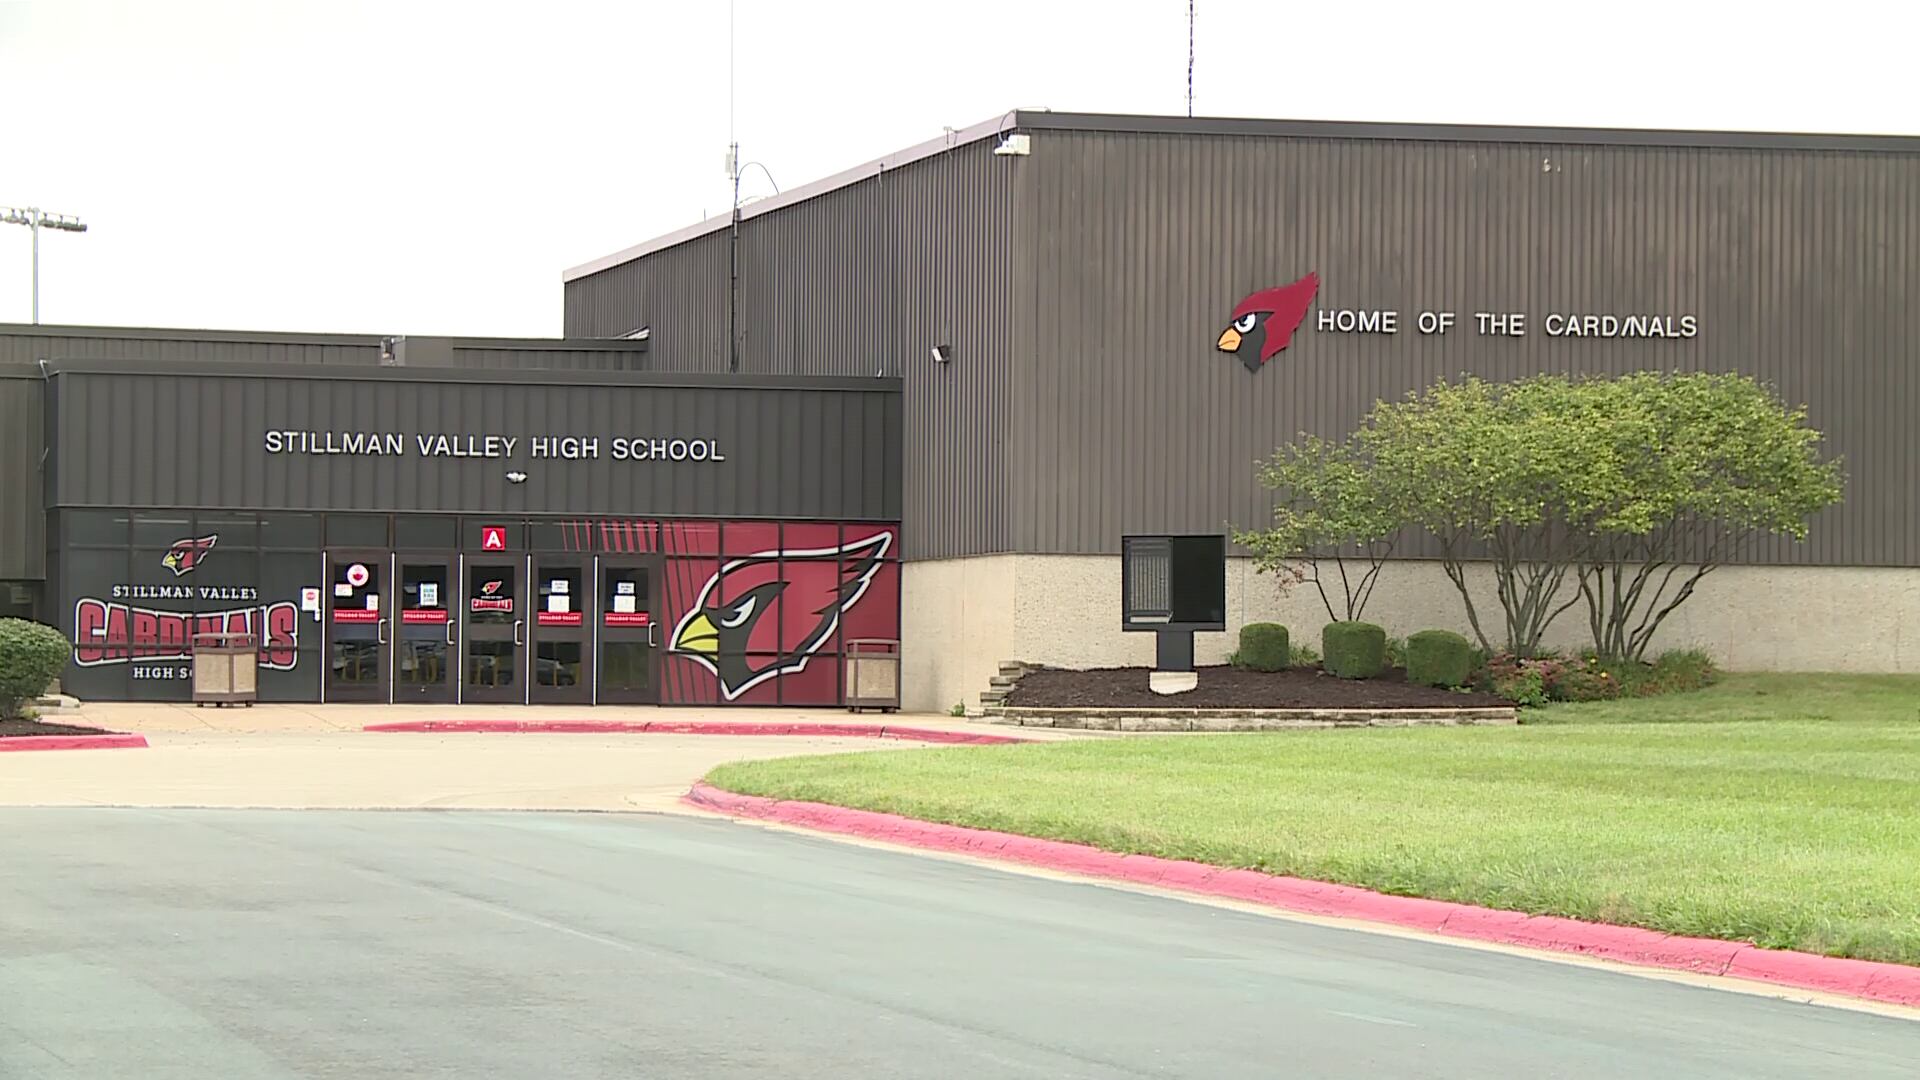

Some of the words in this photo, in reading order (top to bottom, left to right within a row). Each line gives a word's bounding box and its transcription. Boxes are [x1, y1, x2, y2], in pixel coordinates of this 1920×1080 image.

[1317, 310, 1398, 333] HOME
[1418, 312, 1456, 334] OF
[1475, 313, 1526, 335] THE
[1545, 314, 1698, 338] CARDINALS
[265, 431, 404, 455] STILLMAN
[417, 434, 518, 458] VALLEY
[532, 437, 599, 459] HIGH
[612, 438, 726, 461] SCHOOL
[486, 530, 502, 548] A
[113, 585, 194, 599] STILLMAN
[199, 587, 258, 600] VALLEY
[132, 666, 174, 680] HIGH
